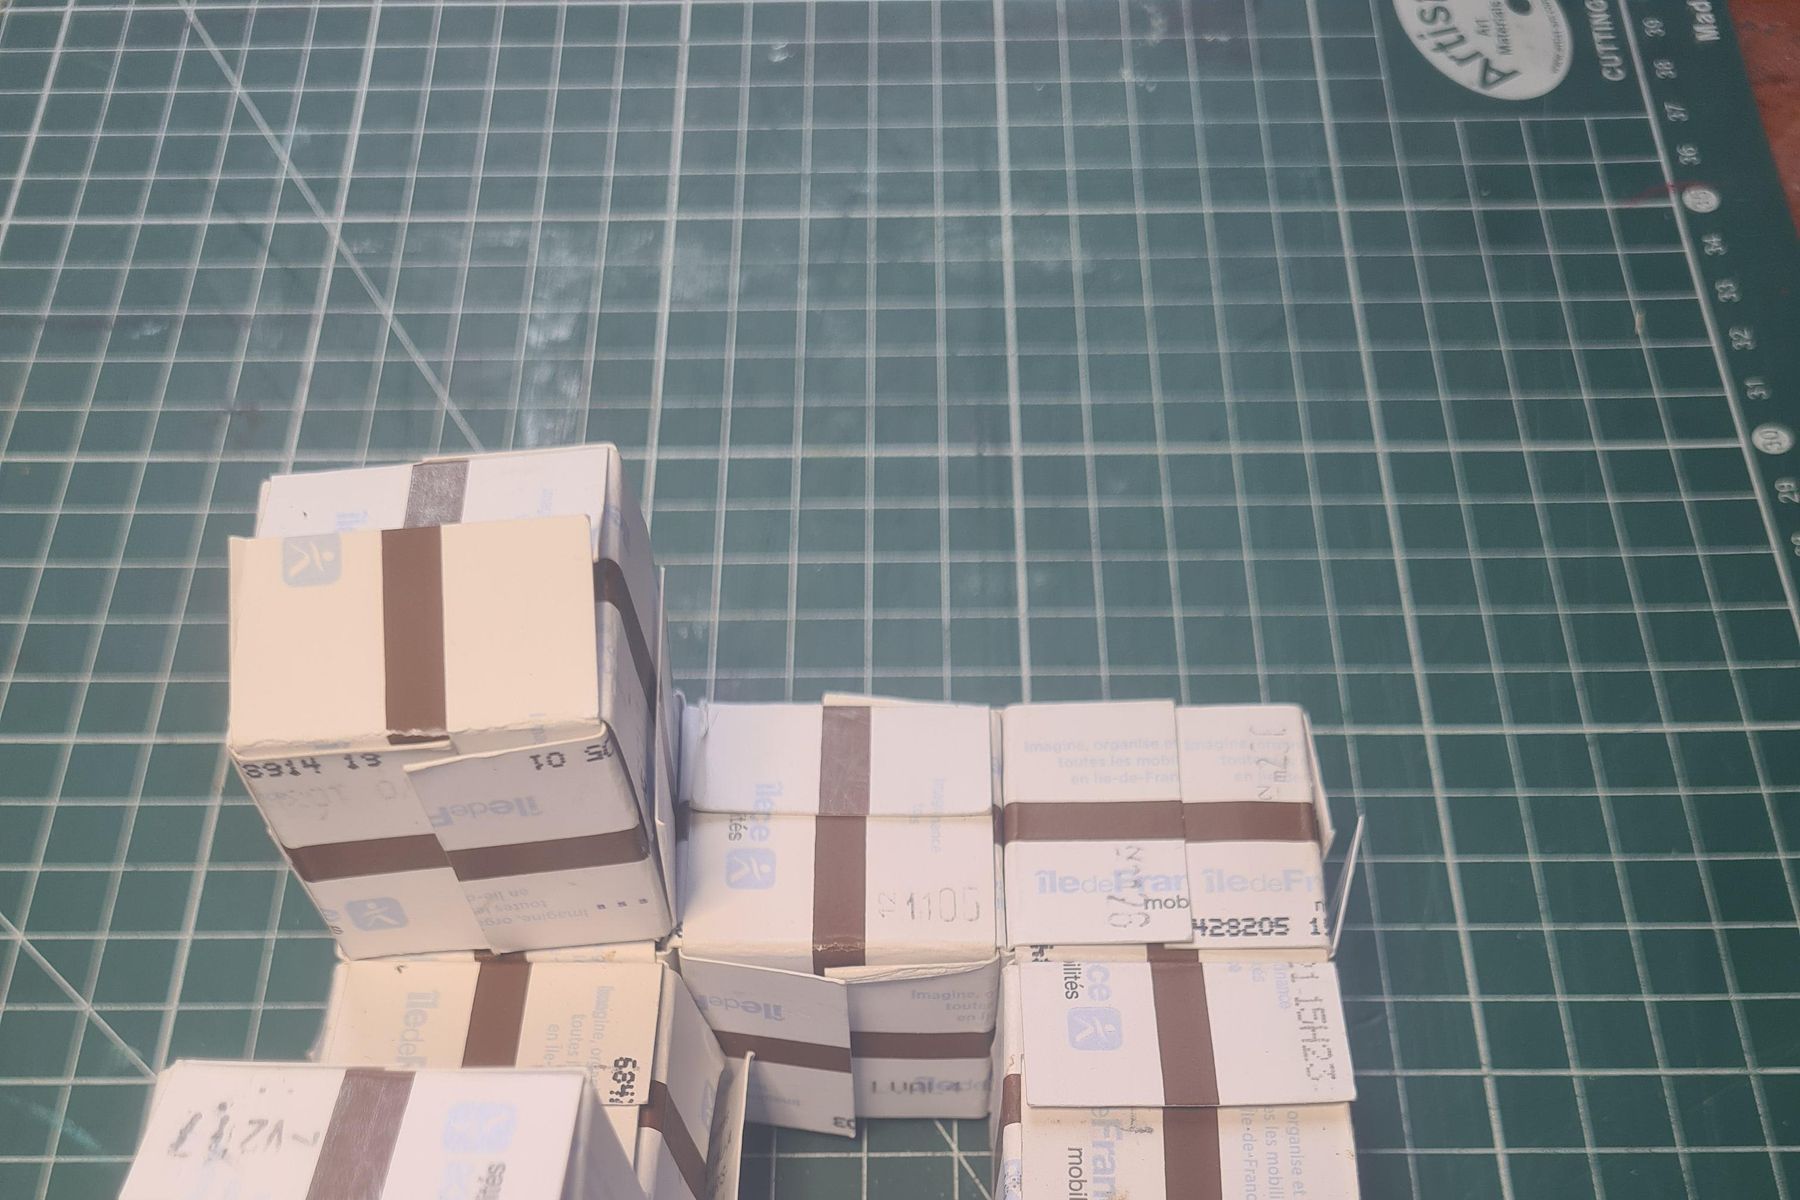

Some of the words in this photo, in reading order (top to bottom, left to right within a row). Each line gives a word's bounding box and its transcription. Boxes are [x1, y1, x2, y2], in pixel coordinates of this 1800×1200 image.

[1642, 17, 1666, 38] 39
[1417, 0, 1521, 91] Artis
[1653, 59, 1678, 80] 38
[1663, 101, 1689, 122] 37
[1676, 143, 1701, 166] 36
[1702, 234, 1728, 257] 34
[1714, 278, 1740, 304] 33
[1728, 326, 1756, 350] 32
[1744, 377, 1771, 400] 31
[1760, 429, 1785, 452] 30
[1285, 1110, 1304, 1177] organise
